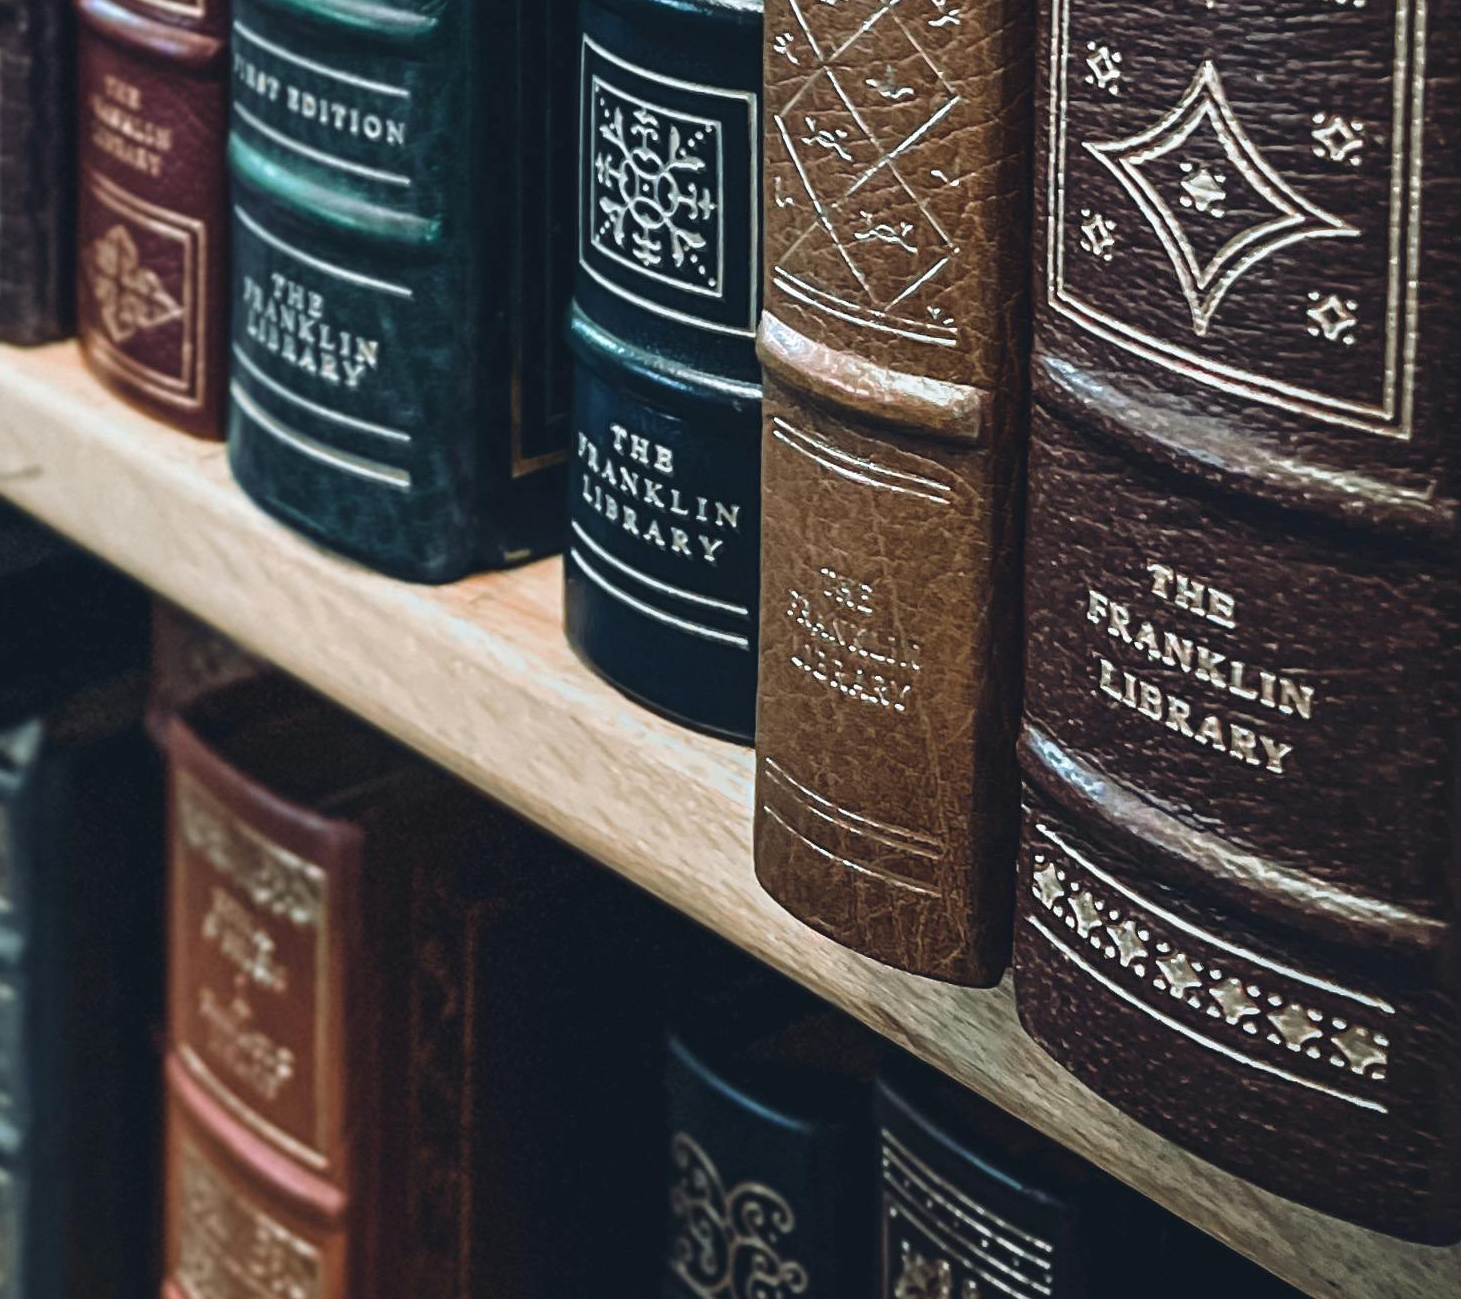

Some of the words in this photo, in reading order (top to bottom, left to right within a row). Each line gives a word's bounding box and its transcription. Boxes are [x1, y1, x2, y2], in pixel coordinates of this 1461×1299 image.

[287, 85, 406, 146] EDITION
[271, 272, 324, 319] THE
[246, 308, 366, 387] LIBRARY
[610, 421, 674, 474] THE
[582, 473, 724, 563] LIBRARY
[1147, 562, 1237, 629] THE
[1086, 588, 1316, 720] FRANKLIN
[1099, 655, 1294, 774] LIBRARY
